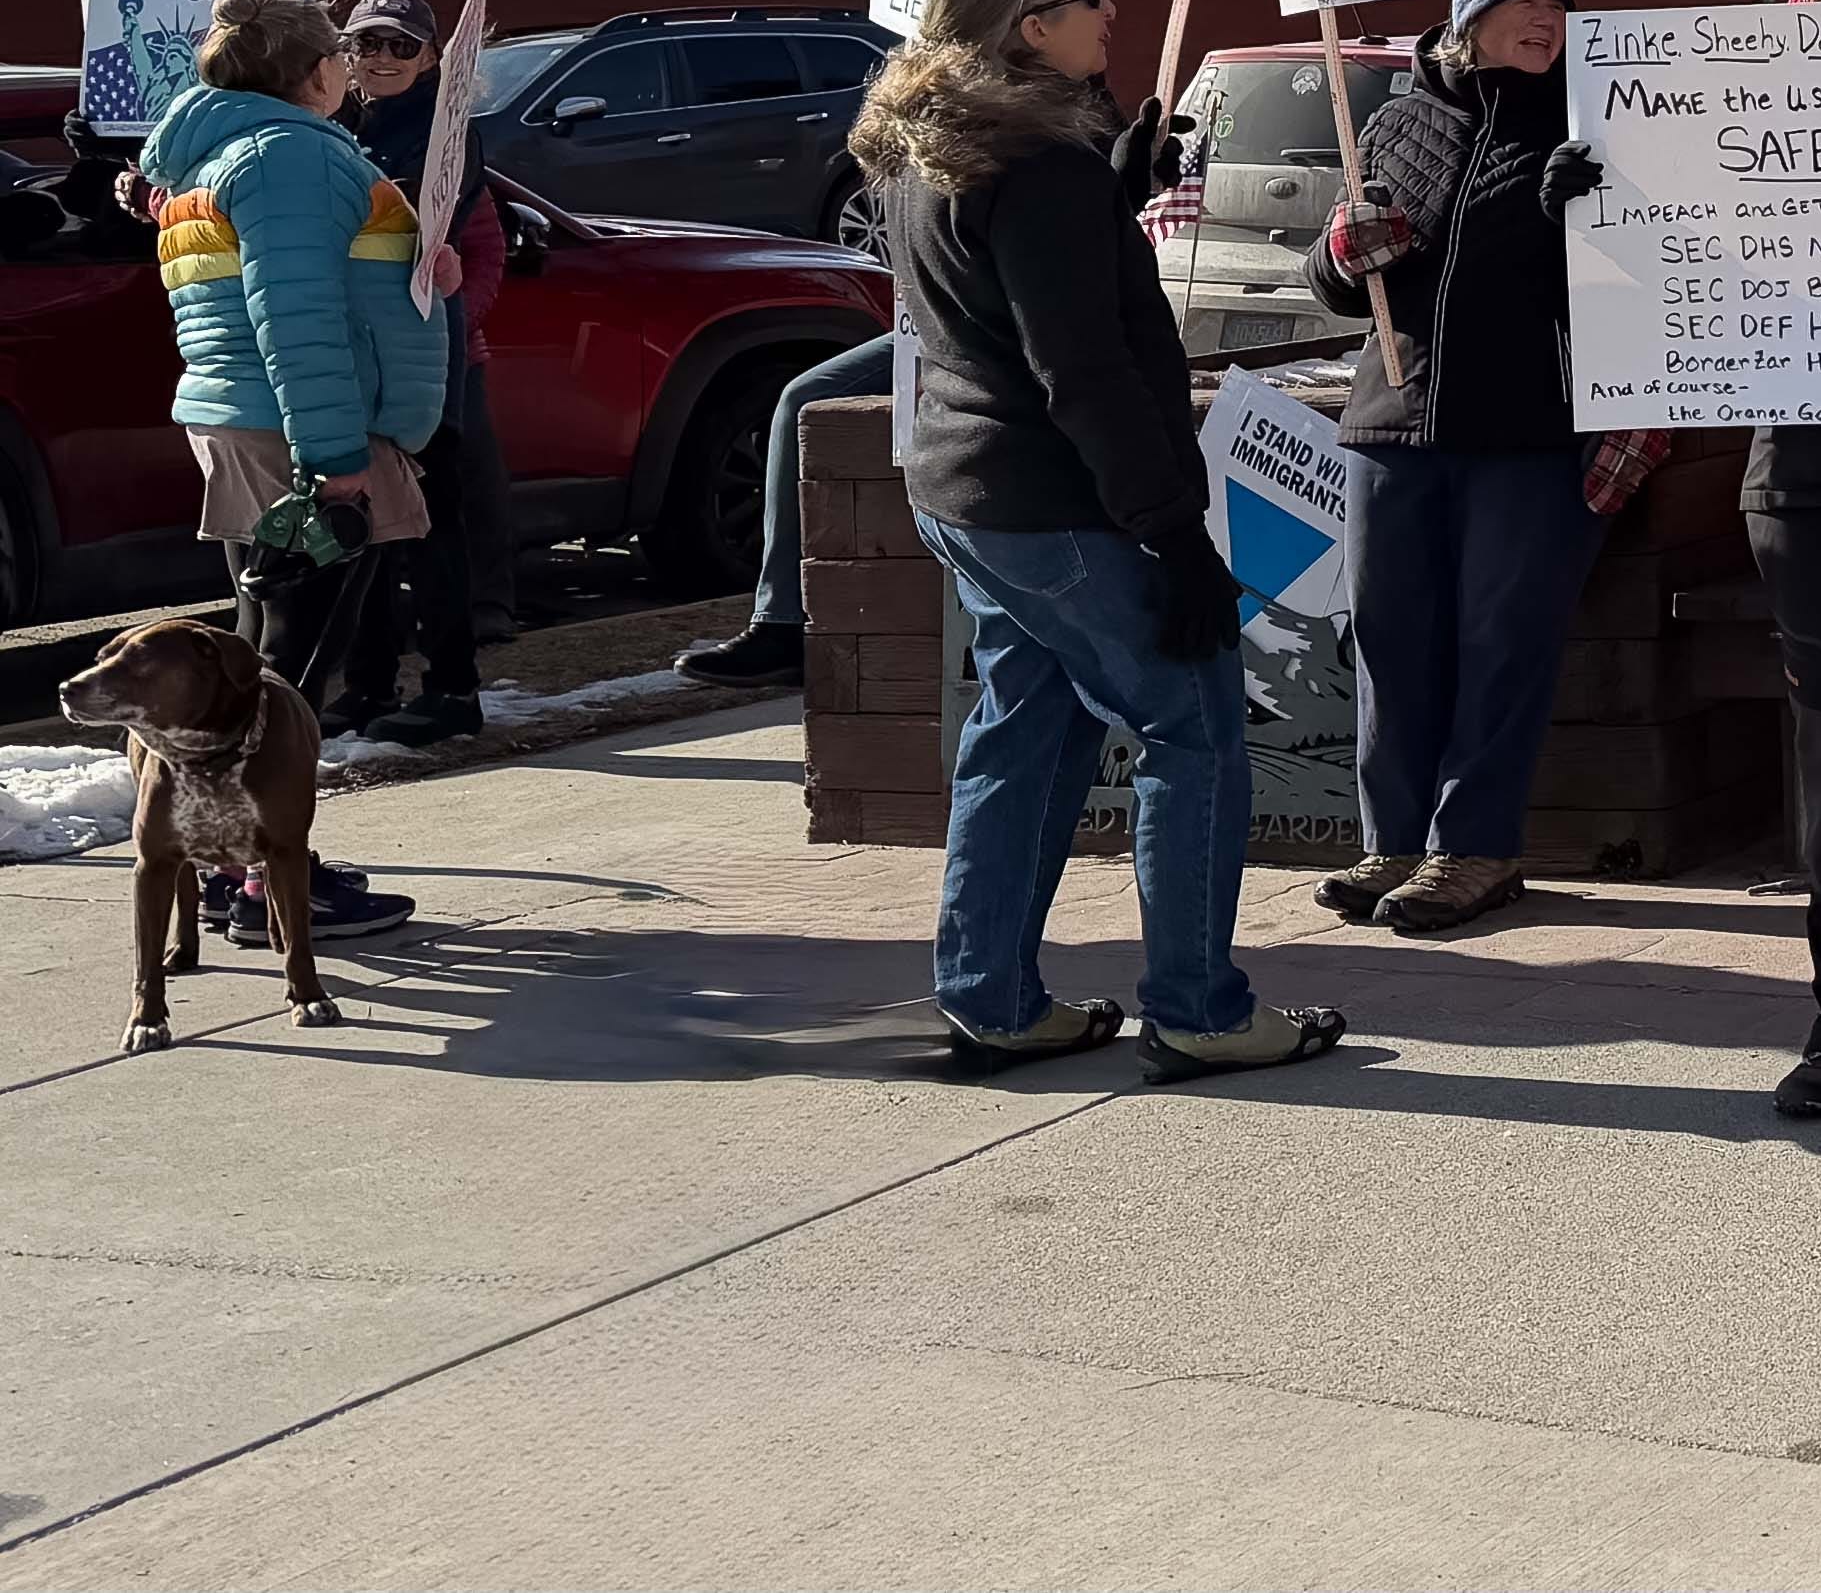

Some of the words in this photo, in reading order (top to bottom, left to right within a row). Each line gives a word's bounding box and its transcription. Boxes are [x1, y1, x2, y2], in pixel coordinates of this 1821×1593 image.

[1604, 78, 1708, 121] MAKE
[1723, 87, 1774, 114] the
[1590, 185, 1718, 229] IMPEACH
[1735, 206, 1777, 218] and
[1660, 235, 1724, 264] SEC
[1739, 235, 1794, 261] DHS
[1663, 277, 1724, 305] SEC
[1741, 279, 1791, 301] DOJ
[1664, 312, 1724, 340] SEC
[1740, 314, 1793, 339] DEF
[1666, 350, 1750, 374] Border
[1590, 382, 1634, 401] And
[1643, 380, 1662, 397] of
[1667, 405, 1706, 422] the
[1717, 404, 1789, 423] Orange
[1240, 409, 1253, 432] I
[1252, 417, 1314, 467] STAND
[1315, 453, 1347, 491] WI
[1229, 434, 1346, 523] IMMIGRANTS
